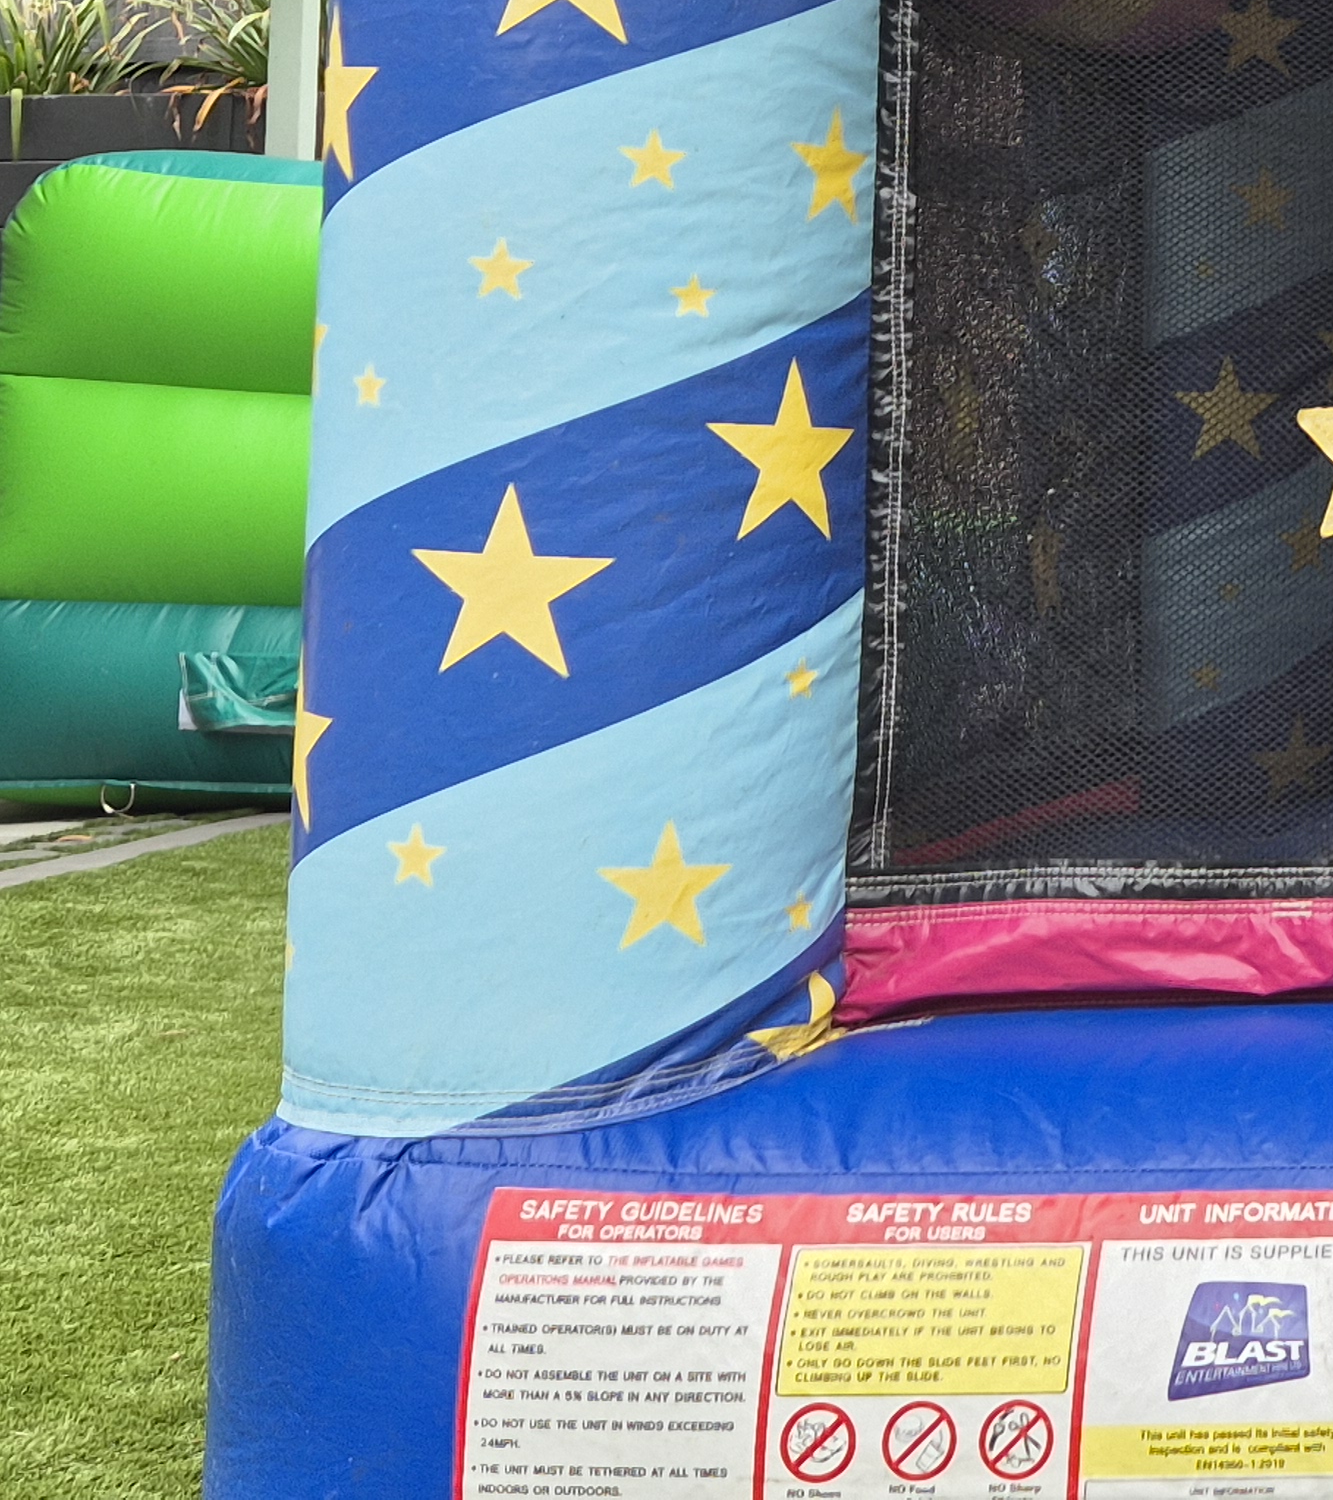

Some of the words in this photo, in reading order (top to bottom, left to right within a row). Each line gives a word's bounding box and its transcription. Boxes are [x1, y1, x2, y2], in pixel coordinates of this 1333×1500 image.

[520, 1200, 613, 1220] SAFETY
[621, 1202, 764, 1224] GUIDELINES
[847, 1202, 944, 1223] SAFETY
[951, 1202, 1032, 1223] RULES
[1139, 1203, 1197, 1224] UNIT
[557, 1224, 593, 1239] FOR
[600, 1225, 702, 1241] OPERATORS
[884, 1227, 921, 1241] FOR
[927, 1226, 986, 1241] USERS
[1121, 1246, 1164, 1262] THIS
[1172, 1245, 1218, 1261] UNIT
[1224, 1245, 1243, 1260] IS
[503, 1255, 543, 1265] PLEASE
[548, 1255, 583, 1265] REFER
[588, 1256, 602, 1265] TO
[608, 1256, 629, 1266] THE
[633, 1256, 698, 1267] INFLATABLE
[702, 1257, 743, 1267] GAMES
[499, 1275, 568, 1285] OPERATIONS
[573, 1275, 617, 1285] MANUAL
[619, 1276, 677, 1286] PROVIDED
[682, 1276, 698, 1285] BY
[702, 1276, 724, 1286] THE
[492, 1323, 537, 1334] TRAINED
[621, 1326, 652, 1335] MUST
[657, 1326, 672, 1335] BE
[677, 1326, 694, 1336] ON
[699, 1326, 730, 1336] DUTY
[734, 1326, 749, 1336] AT
[488, 1344, 506, 1354] ALL
[1181, 1340, 1305, 1368] BLAST
[485, 1369, 501, 1379] DO
[506, 1370, 529, 1379] NOT
[534, 1370, 592, 1380] ASSEMBLE
[598, 1371, 618, 1381] THE
[623, 1371, 648, 1382] UNIT
[653, 1372, 670, 1382] ON
[675, 1372, 682, 1382] A
[687, 1372, 712, 1382] SITE
[717, 1372, 746, 1382] WITH
[483, 1390, 514, 1400] MORE
[520, 1391, 549, 1400] THAN
[553, 1391, 560, 1400] A
[587, 1391, 624, 1401] SLOPE
[628, 1392, 639, 1401] IN
[644, 1392, 668, 1402] ANY
[675, 1392, 745, 1402] DIRECTION.
[481, 1419, 498, 1428] DO
[502, 1419, 524, 1429] NOT
[530, 1420, 551, 1429] USE
[557, 1420, 577, 1430] THE
[582, 1421, 607, 1430] UNIT
[611, 1421, 623, 1430] IN
[626, 1421, 664, 1430] WINDS
[668, 1421, 734, 1431] EXCEEDING
[480, 1465, 500, 1474] THE
[505, 1465, 529, 1474] UNIT
[533, 1466, 564, 1476] MUST
[569, 1466, 583, 1476] BE
[589, 1467, 646, 1477] TETHERED
[651, 1468, 665, 1477] AT
[669, 1468, 689, 1477] ALL
[693, 1468, 727, 1478] TIMES
[478, 1485, 529, 1495] INDOORS
[533, 1486, 550, 1495] OR
